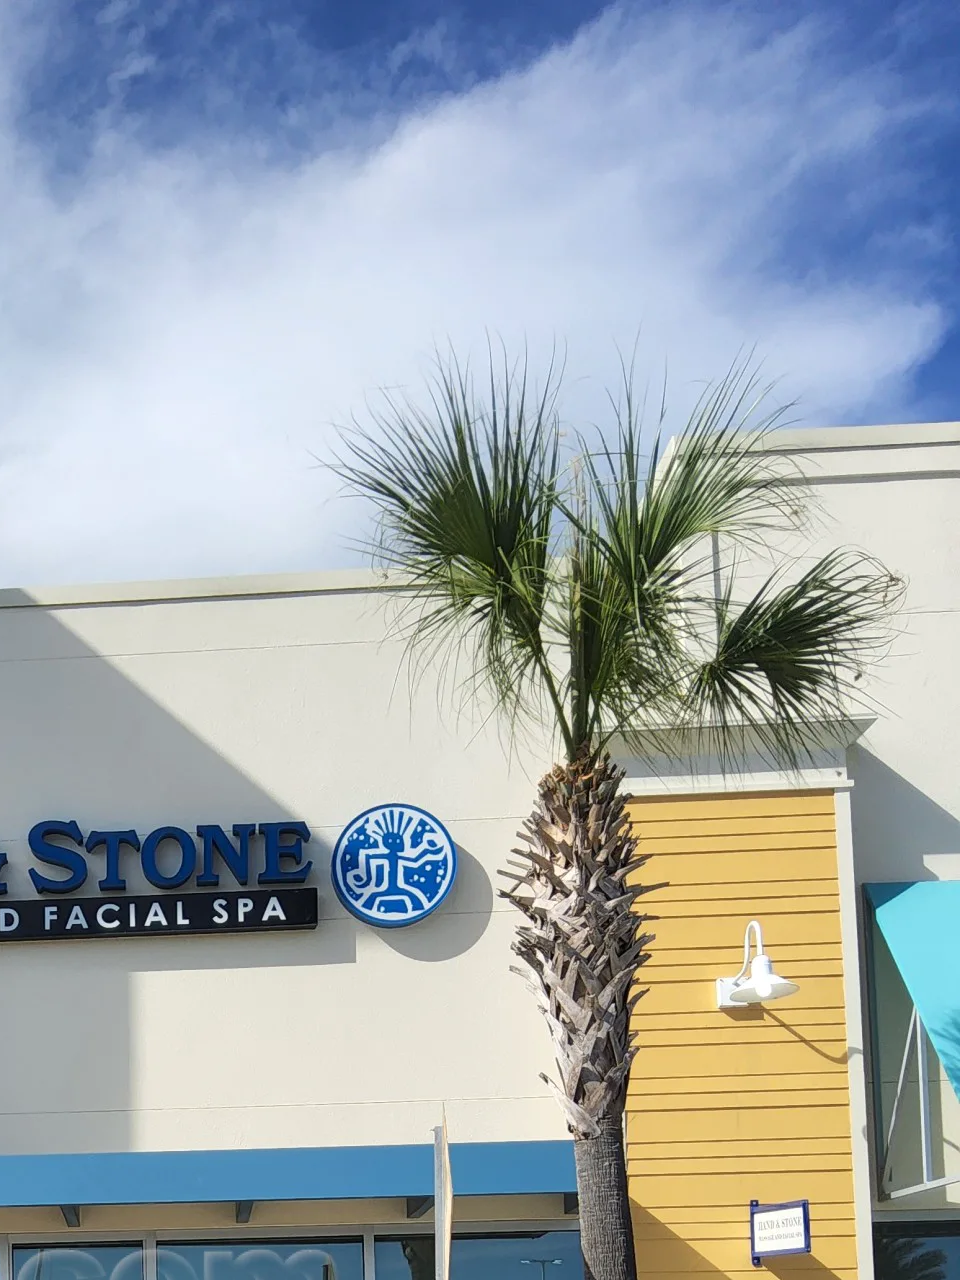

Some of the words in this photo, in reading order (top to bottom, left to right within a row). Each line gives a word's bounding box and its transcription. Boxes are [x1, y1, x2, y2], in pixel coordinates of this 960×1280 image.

[28, 820, 313, 894] STONE
[44, 900, 190, 931] FACIAL
[212, 896, 287, 924] SPA
